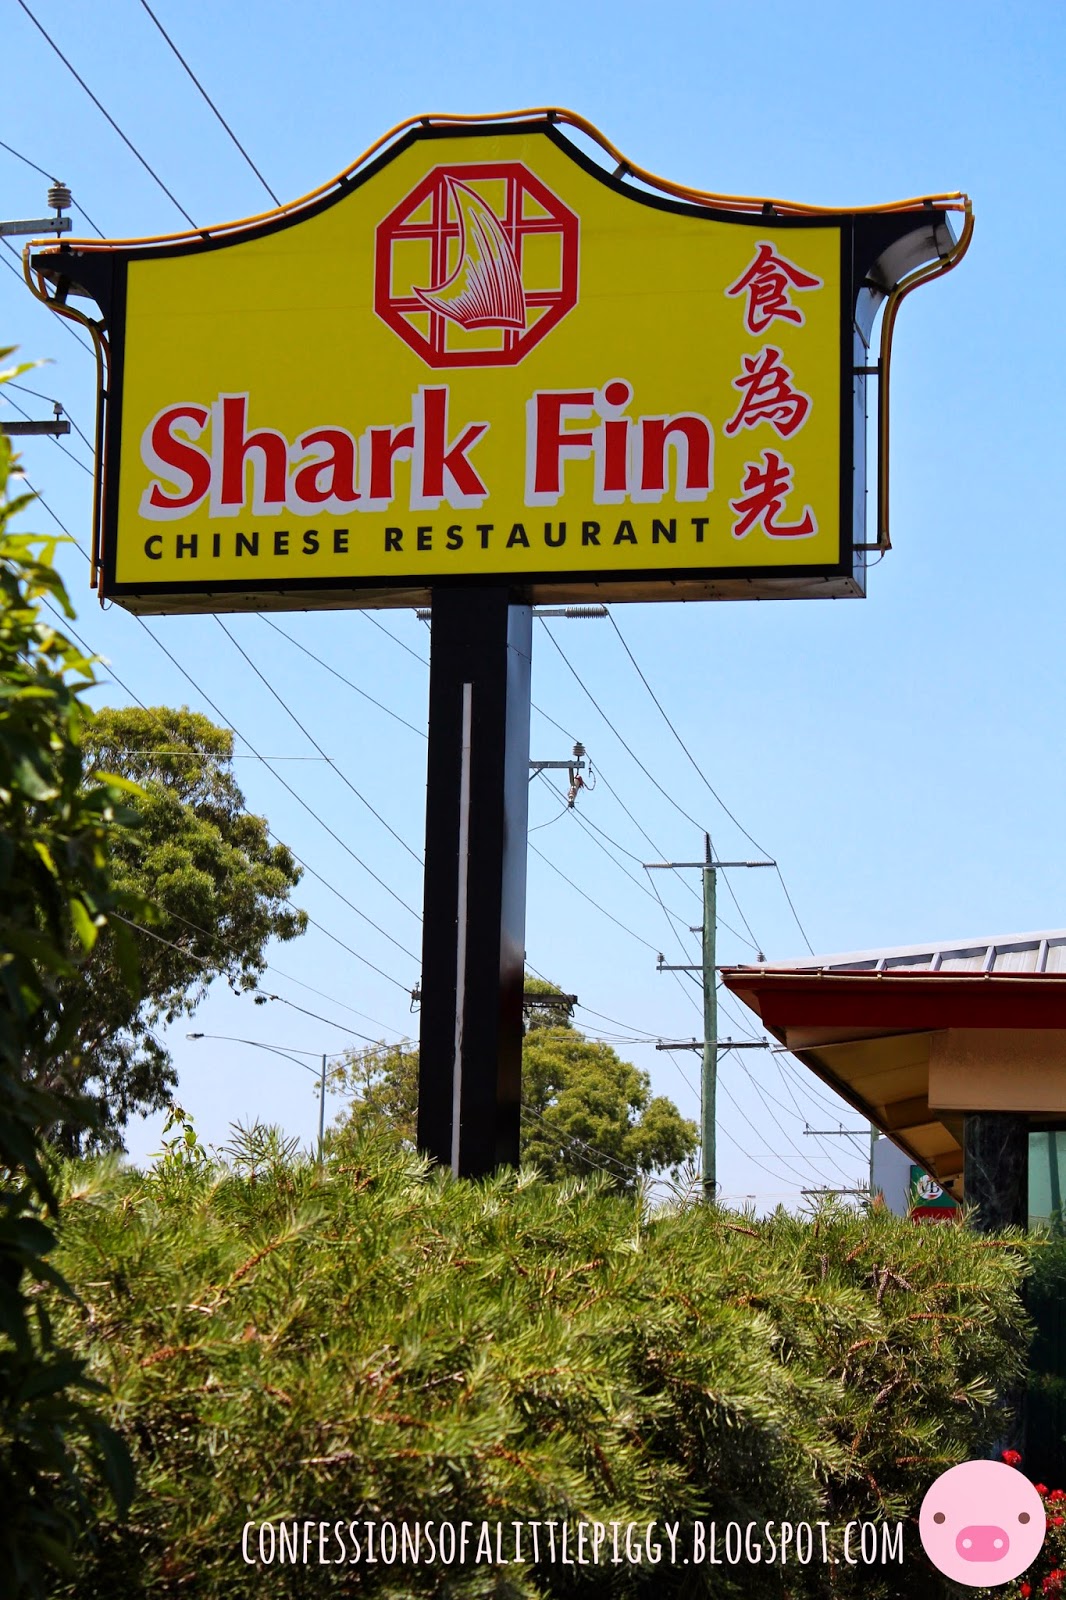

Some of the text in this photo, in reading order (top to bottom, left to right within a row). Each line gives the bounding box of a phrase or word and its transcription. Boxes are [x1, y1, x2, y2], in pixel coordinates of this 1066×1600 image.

[140, 378, 716, 518] Shark Fin
[727, 243, 821, 537] 食為先
[143, 517, 711, 562] CHINESE RESTAURANT
